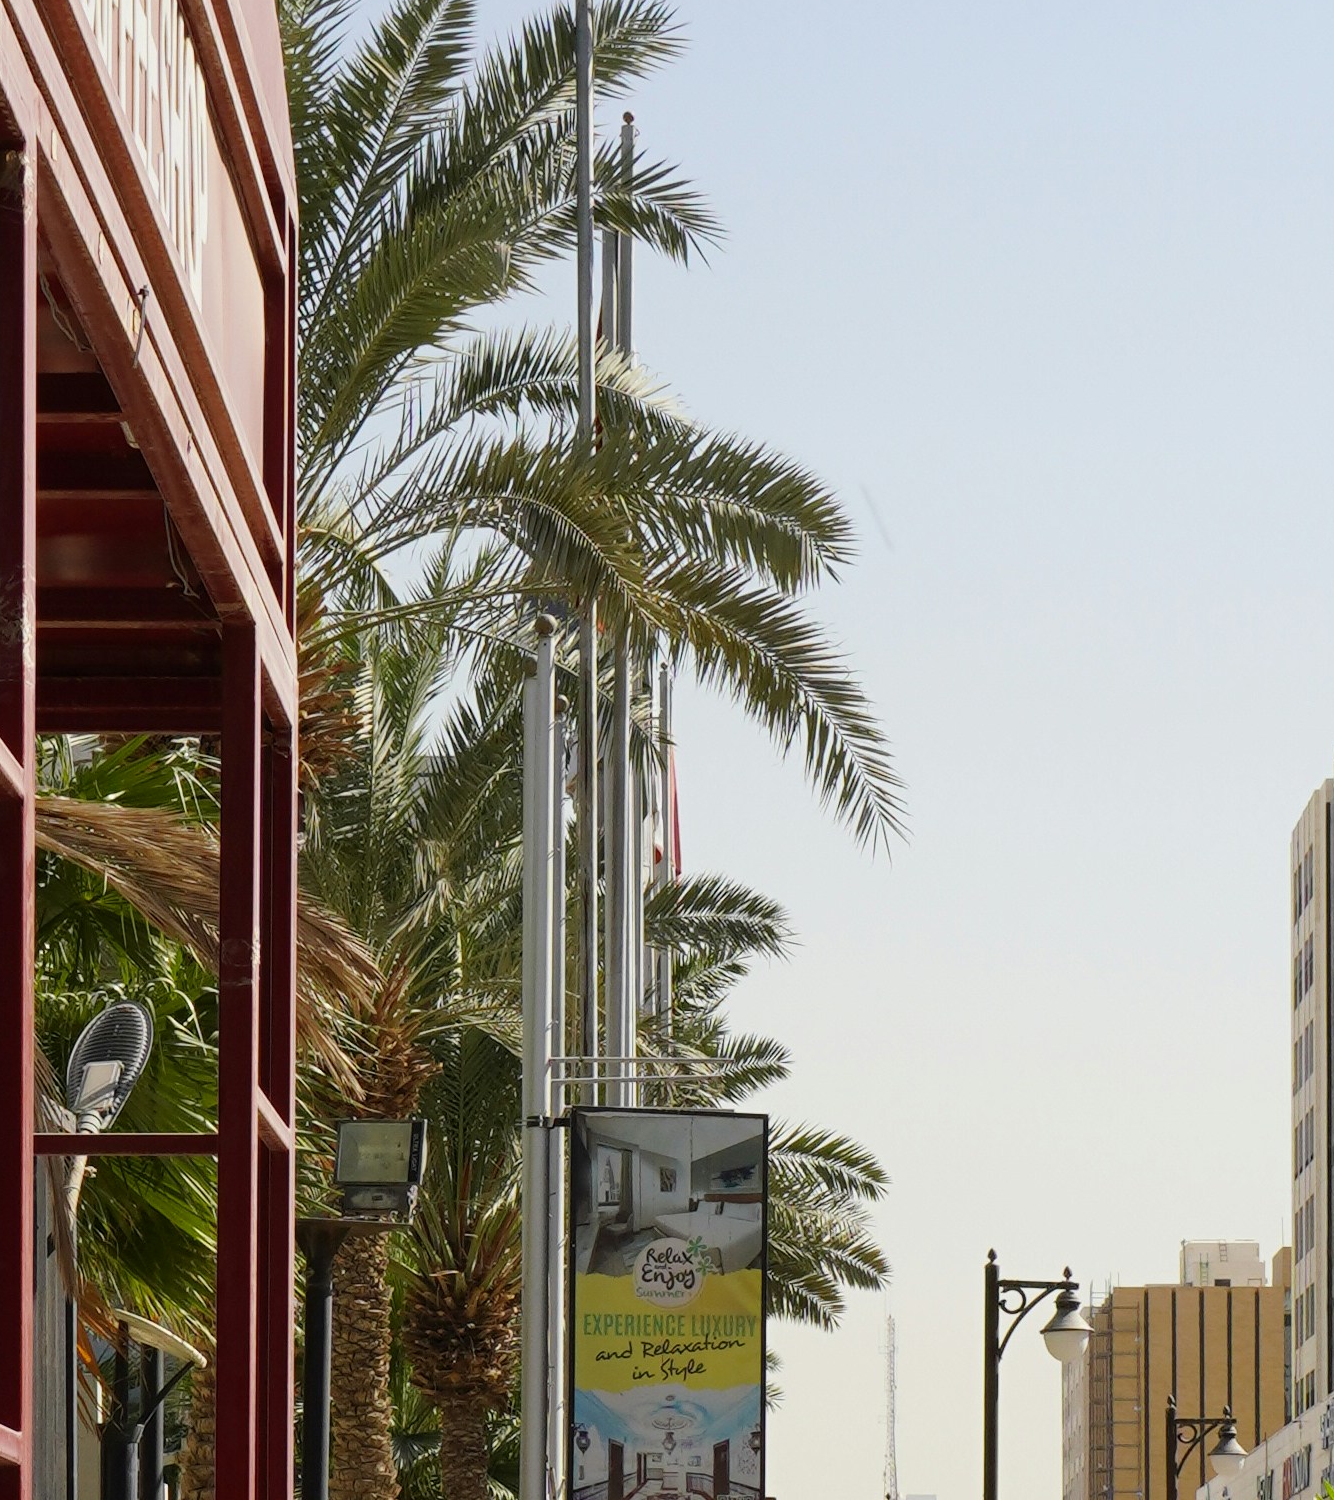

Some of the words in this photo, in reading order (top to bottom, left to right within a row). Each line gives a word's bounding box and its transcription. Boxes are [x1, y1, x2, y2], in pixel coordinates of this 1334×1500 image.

[646, 1246, 694, 1265] Relax
[641, 1263, 696, 1290] Enjoy
[583, 1313, 686, 1337] EXPERIENCE
[691, 1314, 757, 1338] LUXURY
[595, 1341, 633, 1362] and
[640, 1333, 745, 1359] Relaxation
[632, 1366, 655, 1380] in
[660, 1358, 707, 1381] Style
